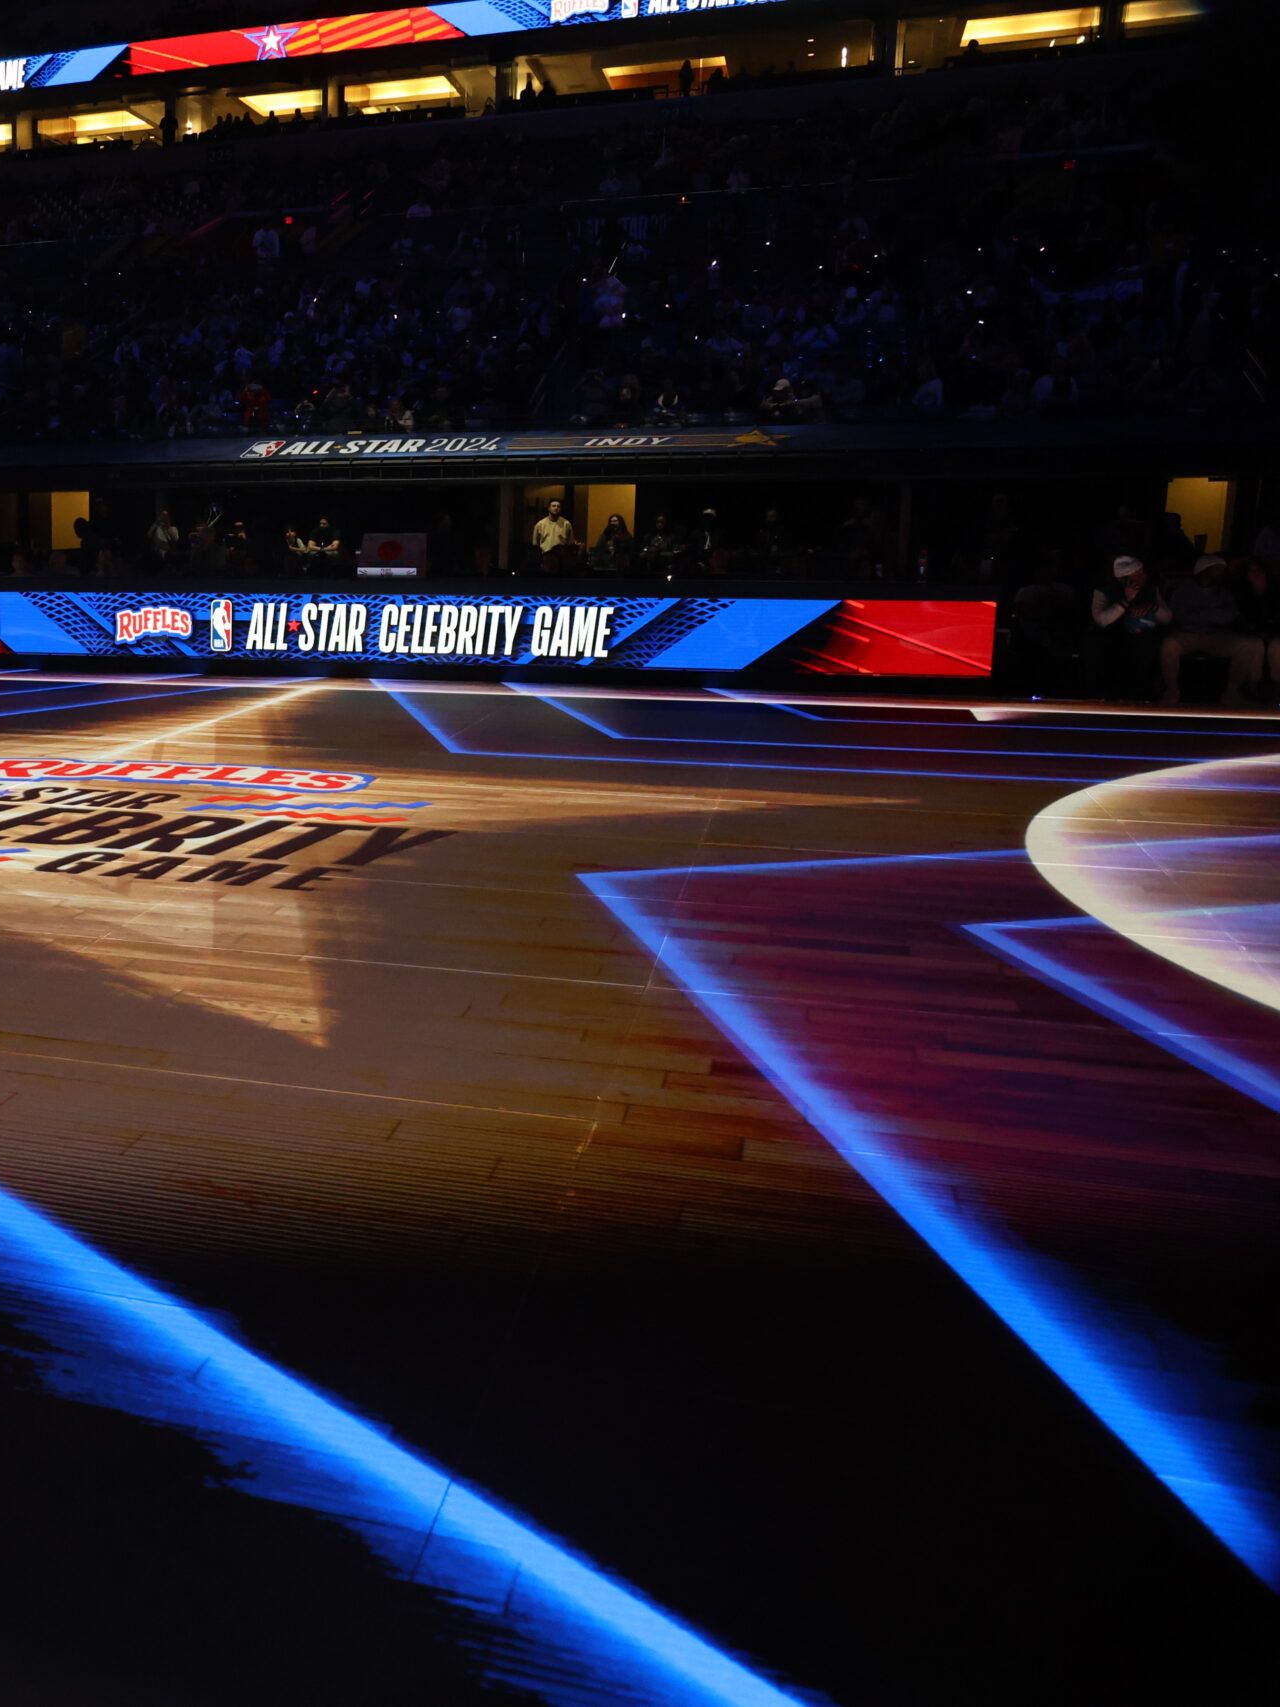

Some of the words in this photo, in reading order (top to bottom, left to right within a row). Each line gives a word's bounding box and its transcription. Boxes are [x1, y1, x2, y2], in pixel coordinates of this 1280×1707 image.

[279, 441, 335, 455] ALL
[339, 440, 423, 454] STAR
[423, 437, 501, 452] 2024
[583, 438, 670, 446] INDY
[118, 608, 190, 639] RUFFLES
[246, 602, 286, 650] ALL
[299, 603, 363, 652] STAR
[378, 604, 523, 655] CELEBRITY
[531, 606, 614, 658] GAME
[35, 851, 356, 892] GAME
